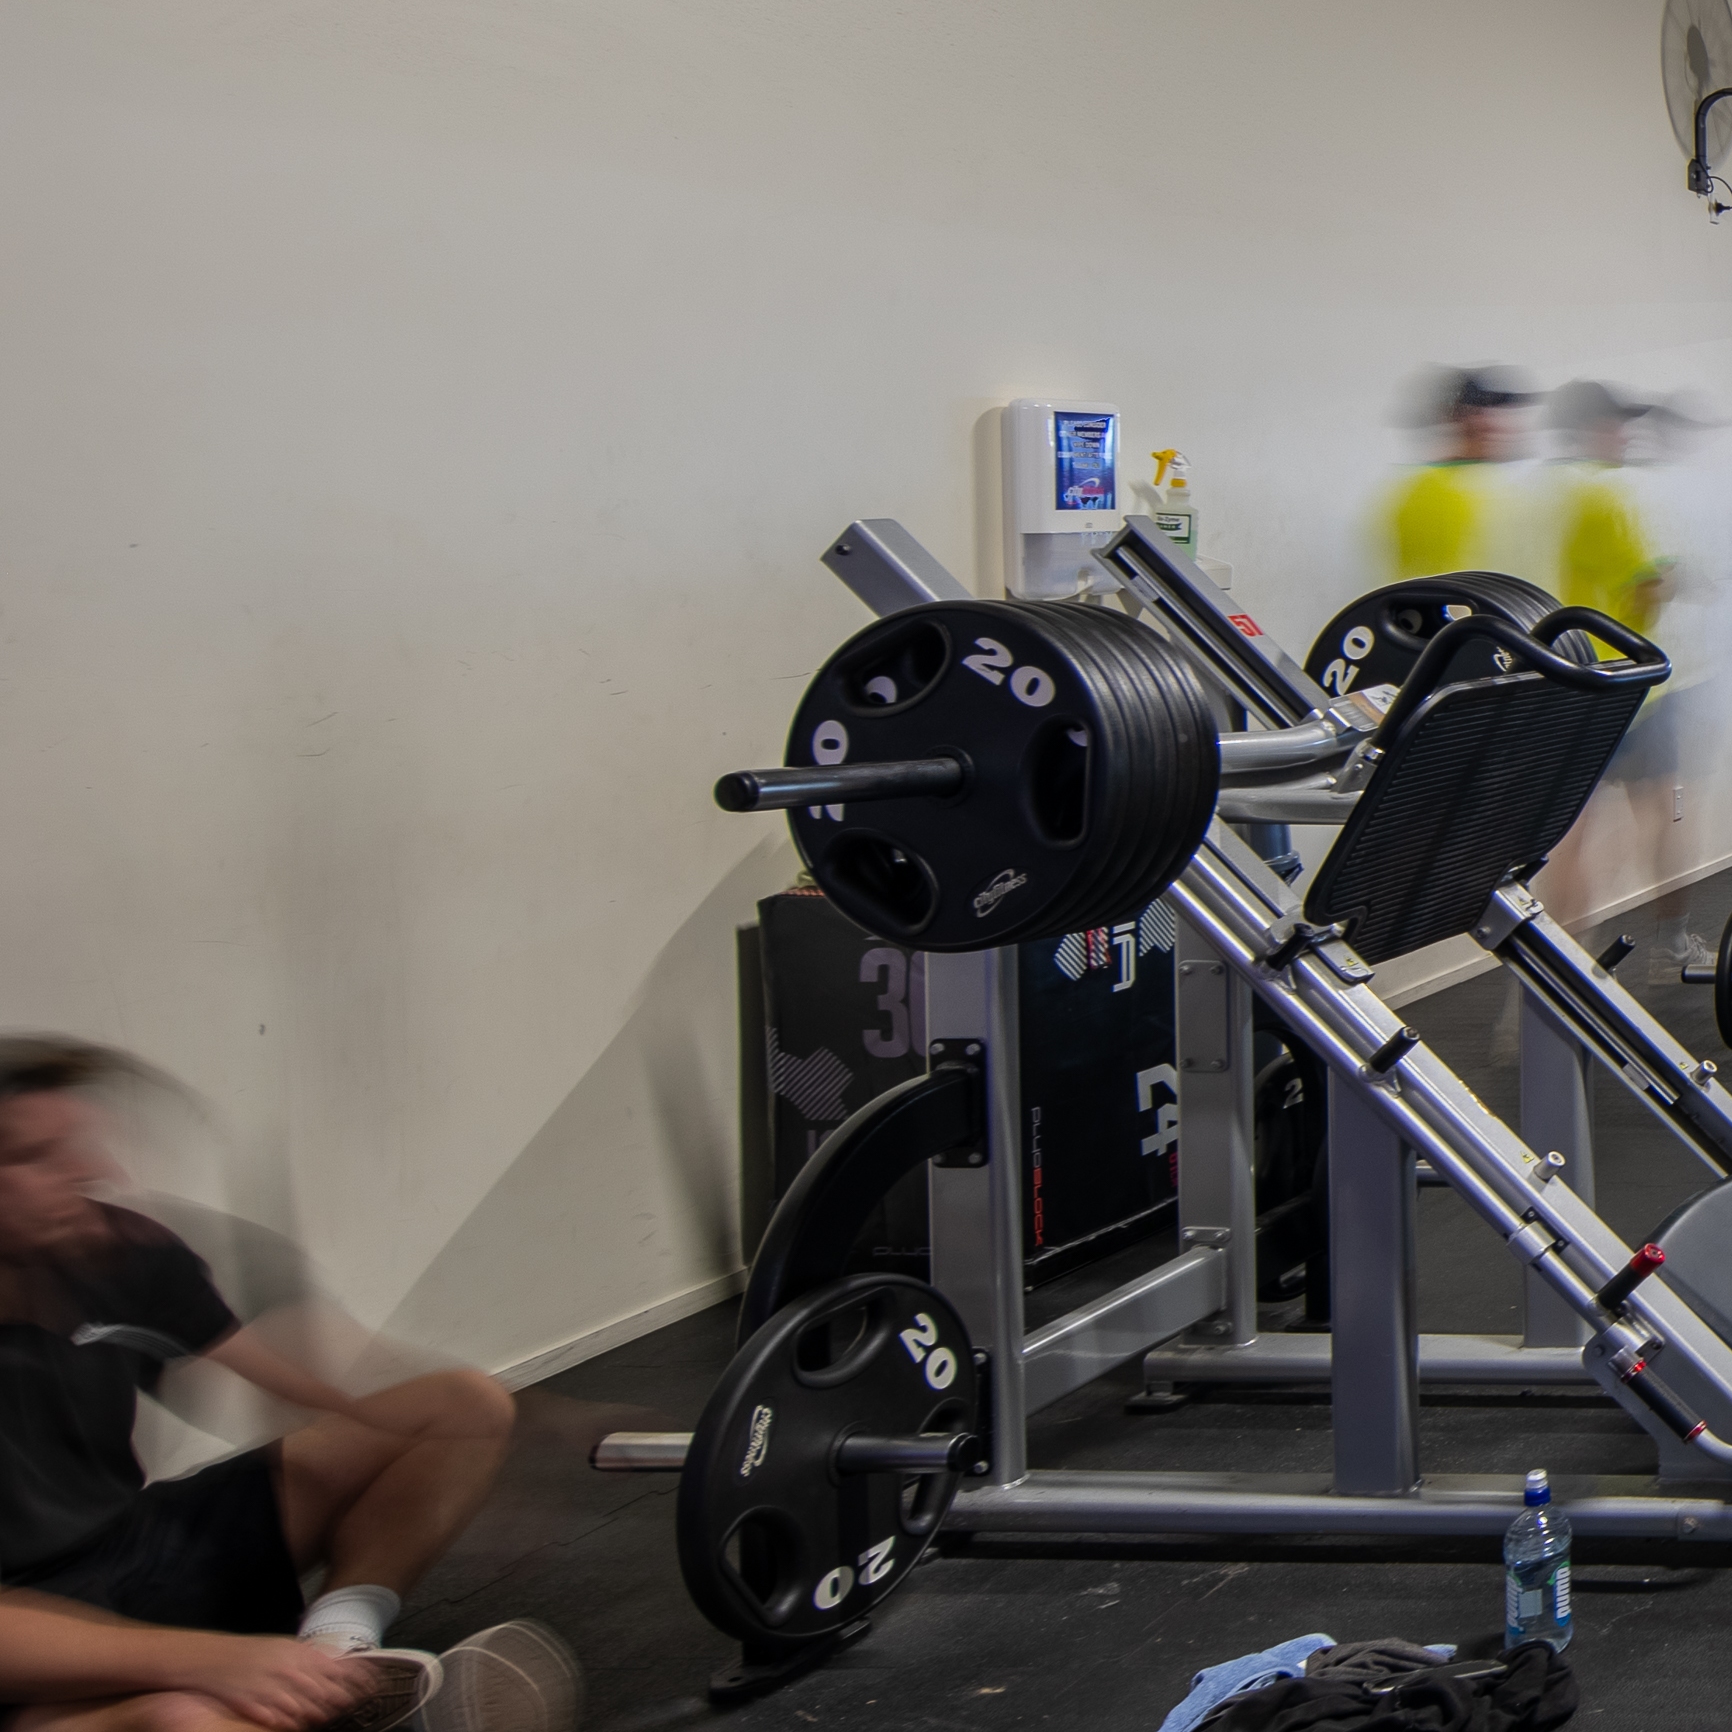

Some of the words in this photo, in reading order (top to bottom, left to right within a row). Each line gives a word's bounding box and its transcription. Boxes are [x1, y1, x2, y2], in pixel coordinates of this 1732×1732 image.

[962, 637, 1056, 708] 20
[1323, 626, 1375, 696] 20
[899, 1312, 957, 1390] 20
[812, 1535, 896, 1610] 20
